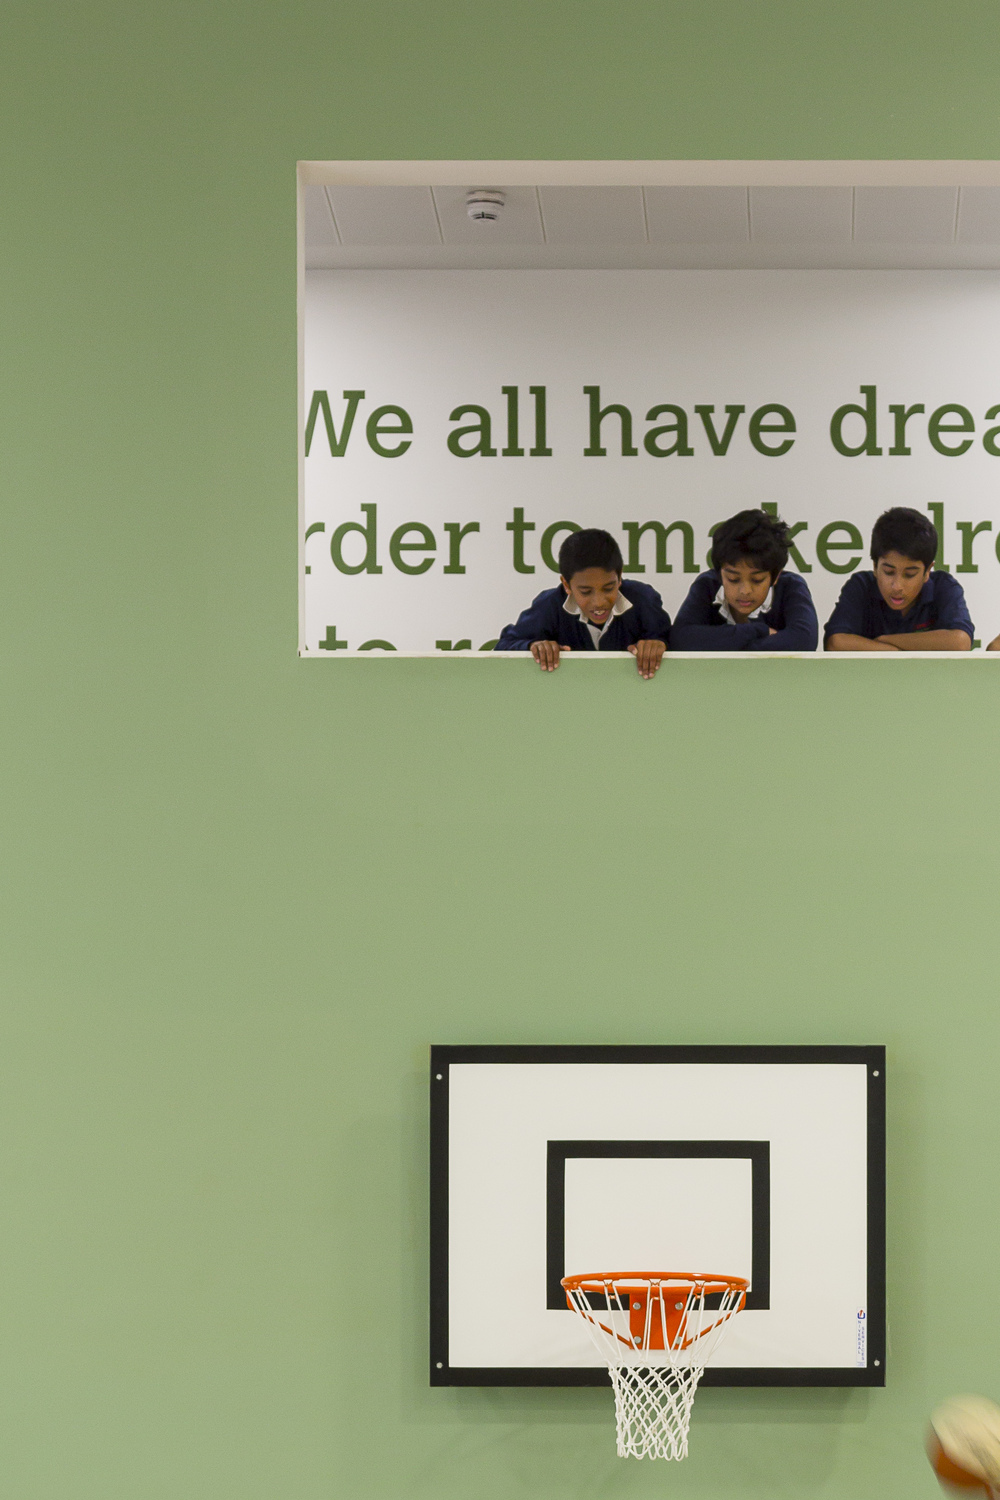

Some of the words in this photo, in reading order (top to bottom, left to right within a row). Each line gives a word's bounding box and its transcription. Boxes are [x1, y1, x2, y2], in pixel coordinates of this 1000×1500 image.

[305, 390, 413, 458] We
[447, 386, 552, 458] all
[583, 386, 797, 457] have
